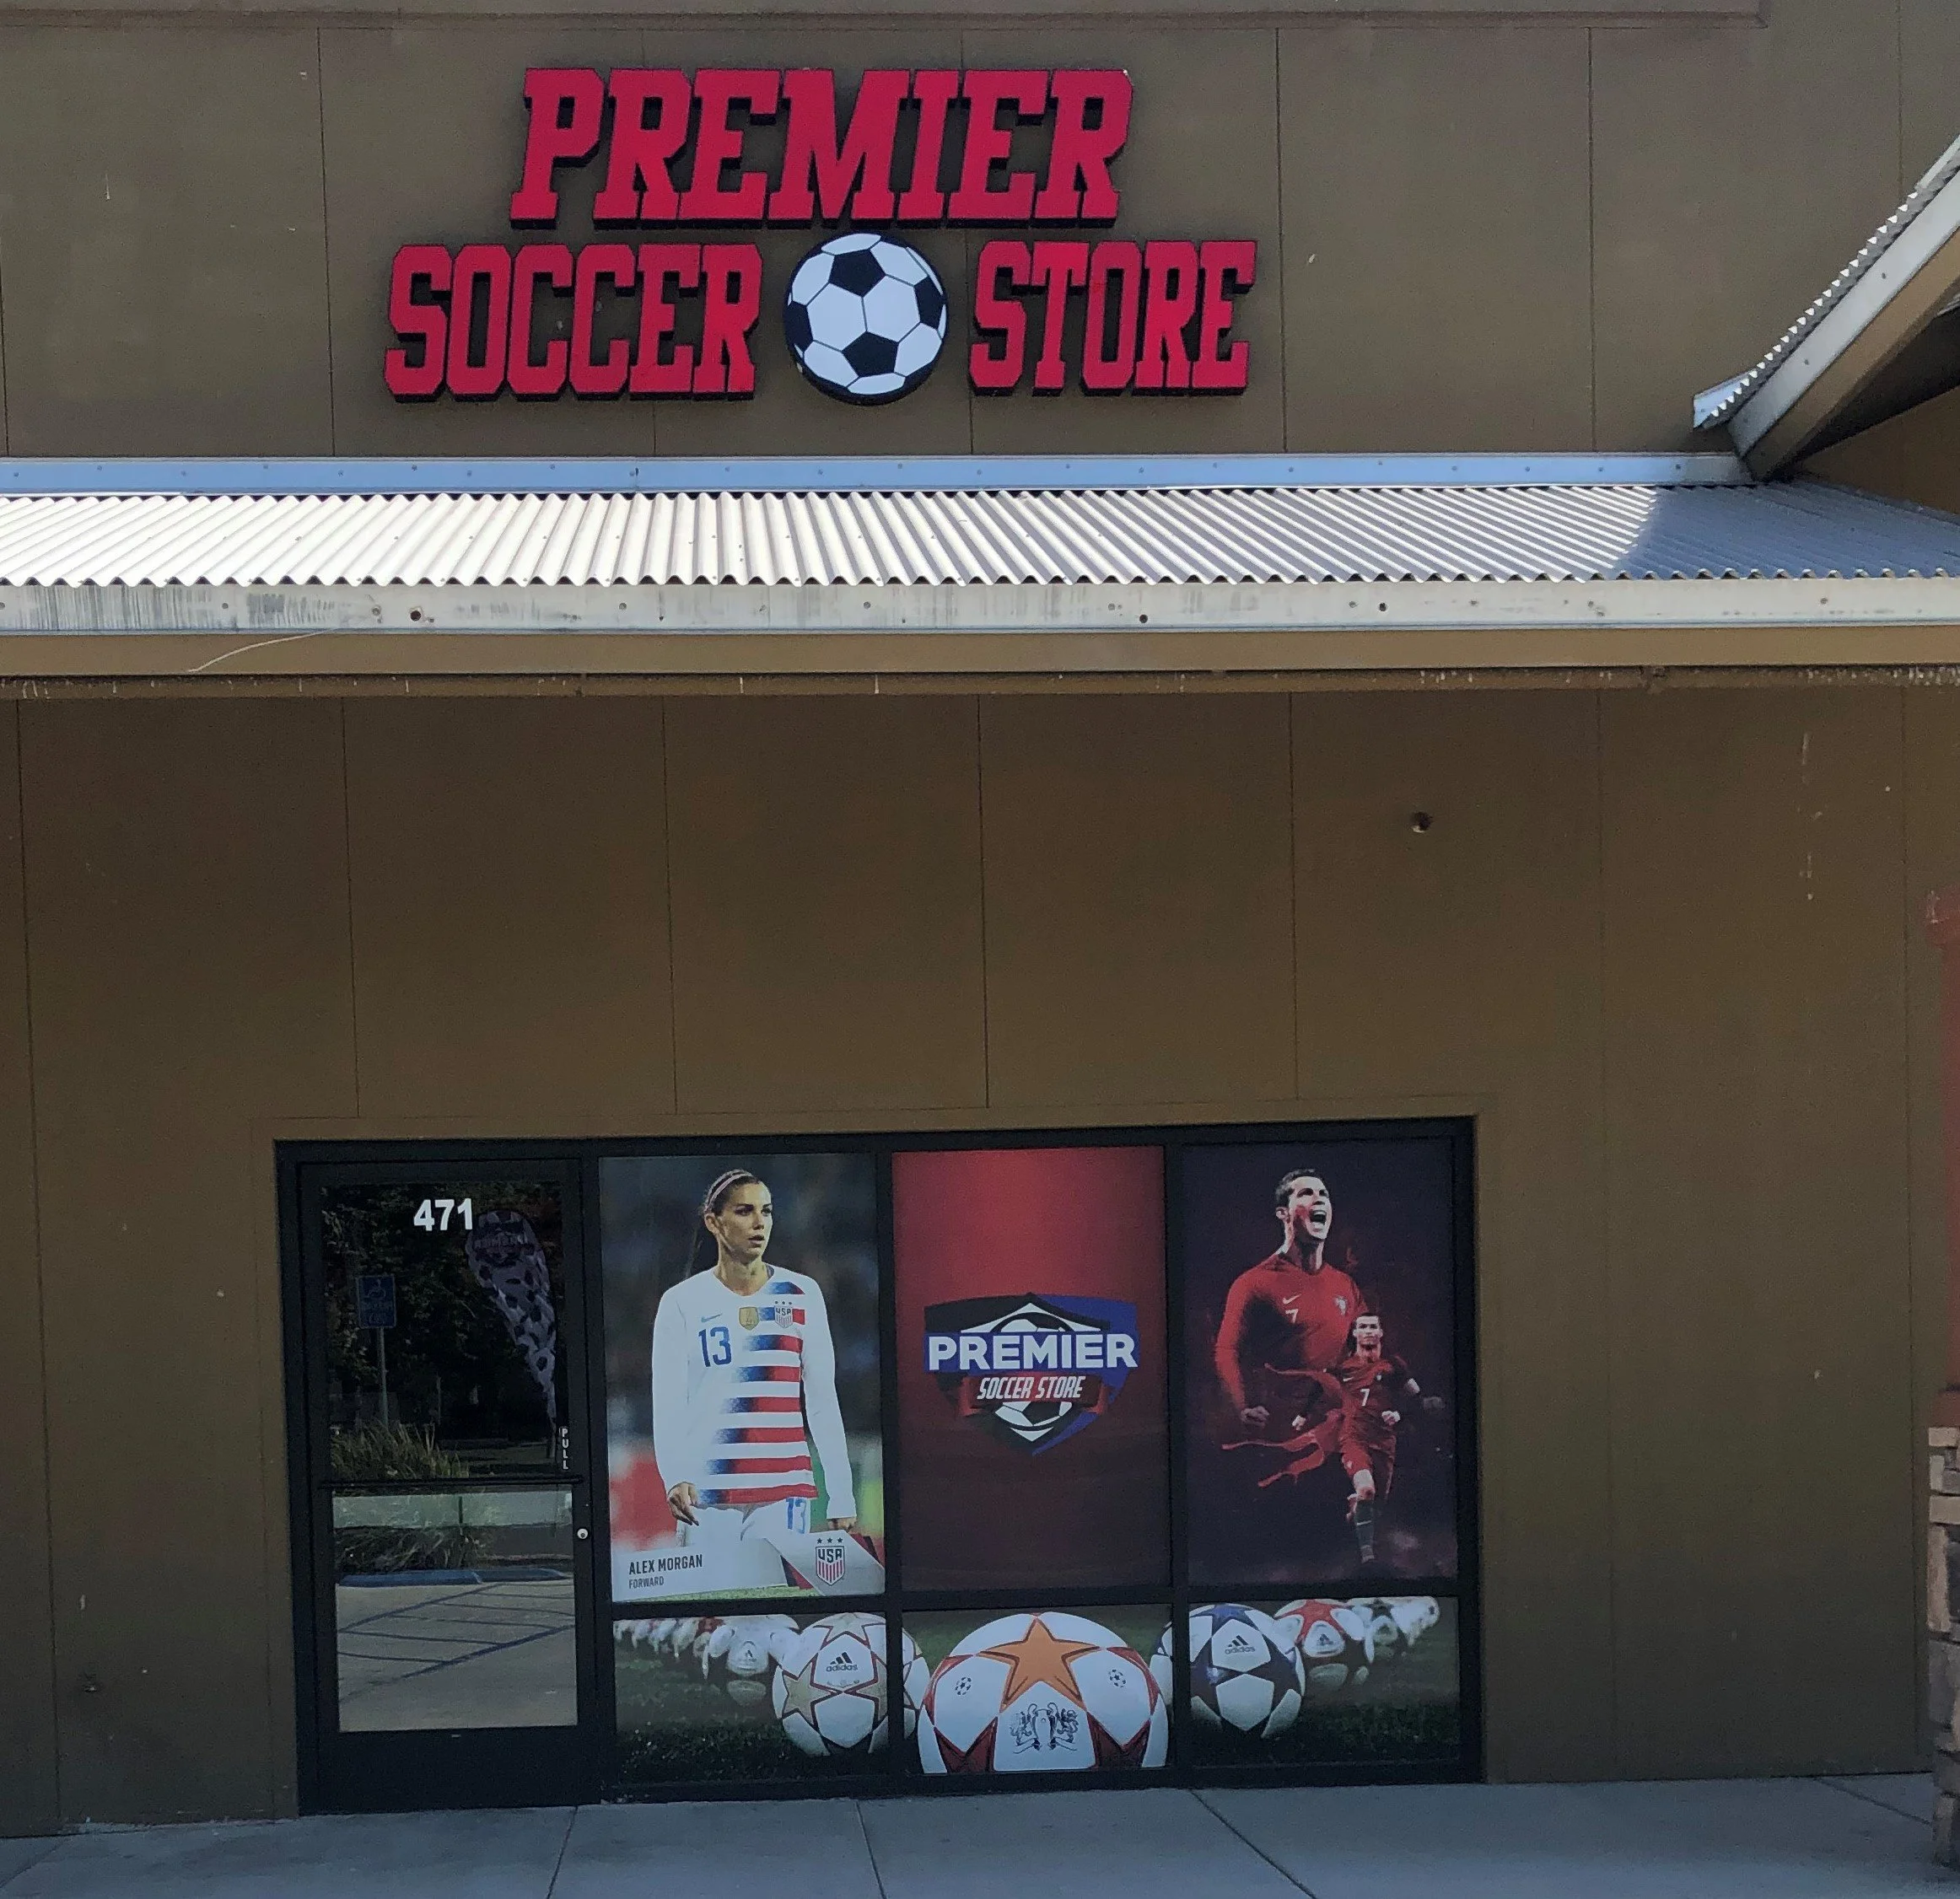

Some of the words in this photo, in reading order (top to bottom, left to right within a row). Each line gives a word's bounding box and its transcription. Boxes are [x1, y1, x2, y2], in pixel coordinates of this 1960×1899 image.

[510, 68, 1133, 229] PREMIER
[385, 244, 763, 401] SOCCER
[969, 240, 1257, 396] STORE
[413, 1198, 473, 1231] 471
[1285, 1310, 1298, 1323] 7
[698, 1326, 731, 1368] 13
[929, 1333, 1138, 1370] PREMIER
[977, 1376, 1034, 1400] SOCCER
[1036, 1375, 1085, 1398] STORE
[1360, 1389, 1370, 1406] 7
[786, 1498, 807, 1535] 13
[628, 1559, 655, 1575] ALEX
[658, 1554, 703, 1572] MORGAN
[818, 1548, 843, 1563] USA
[628, 1575, 665, 1589] FORWARD
[826, 1664, 858, 1672] adidas
